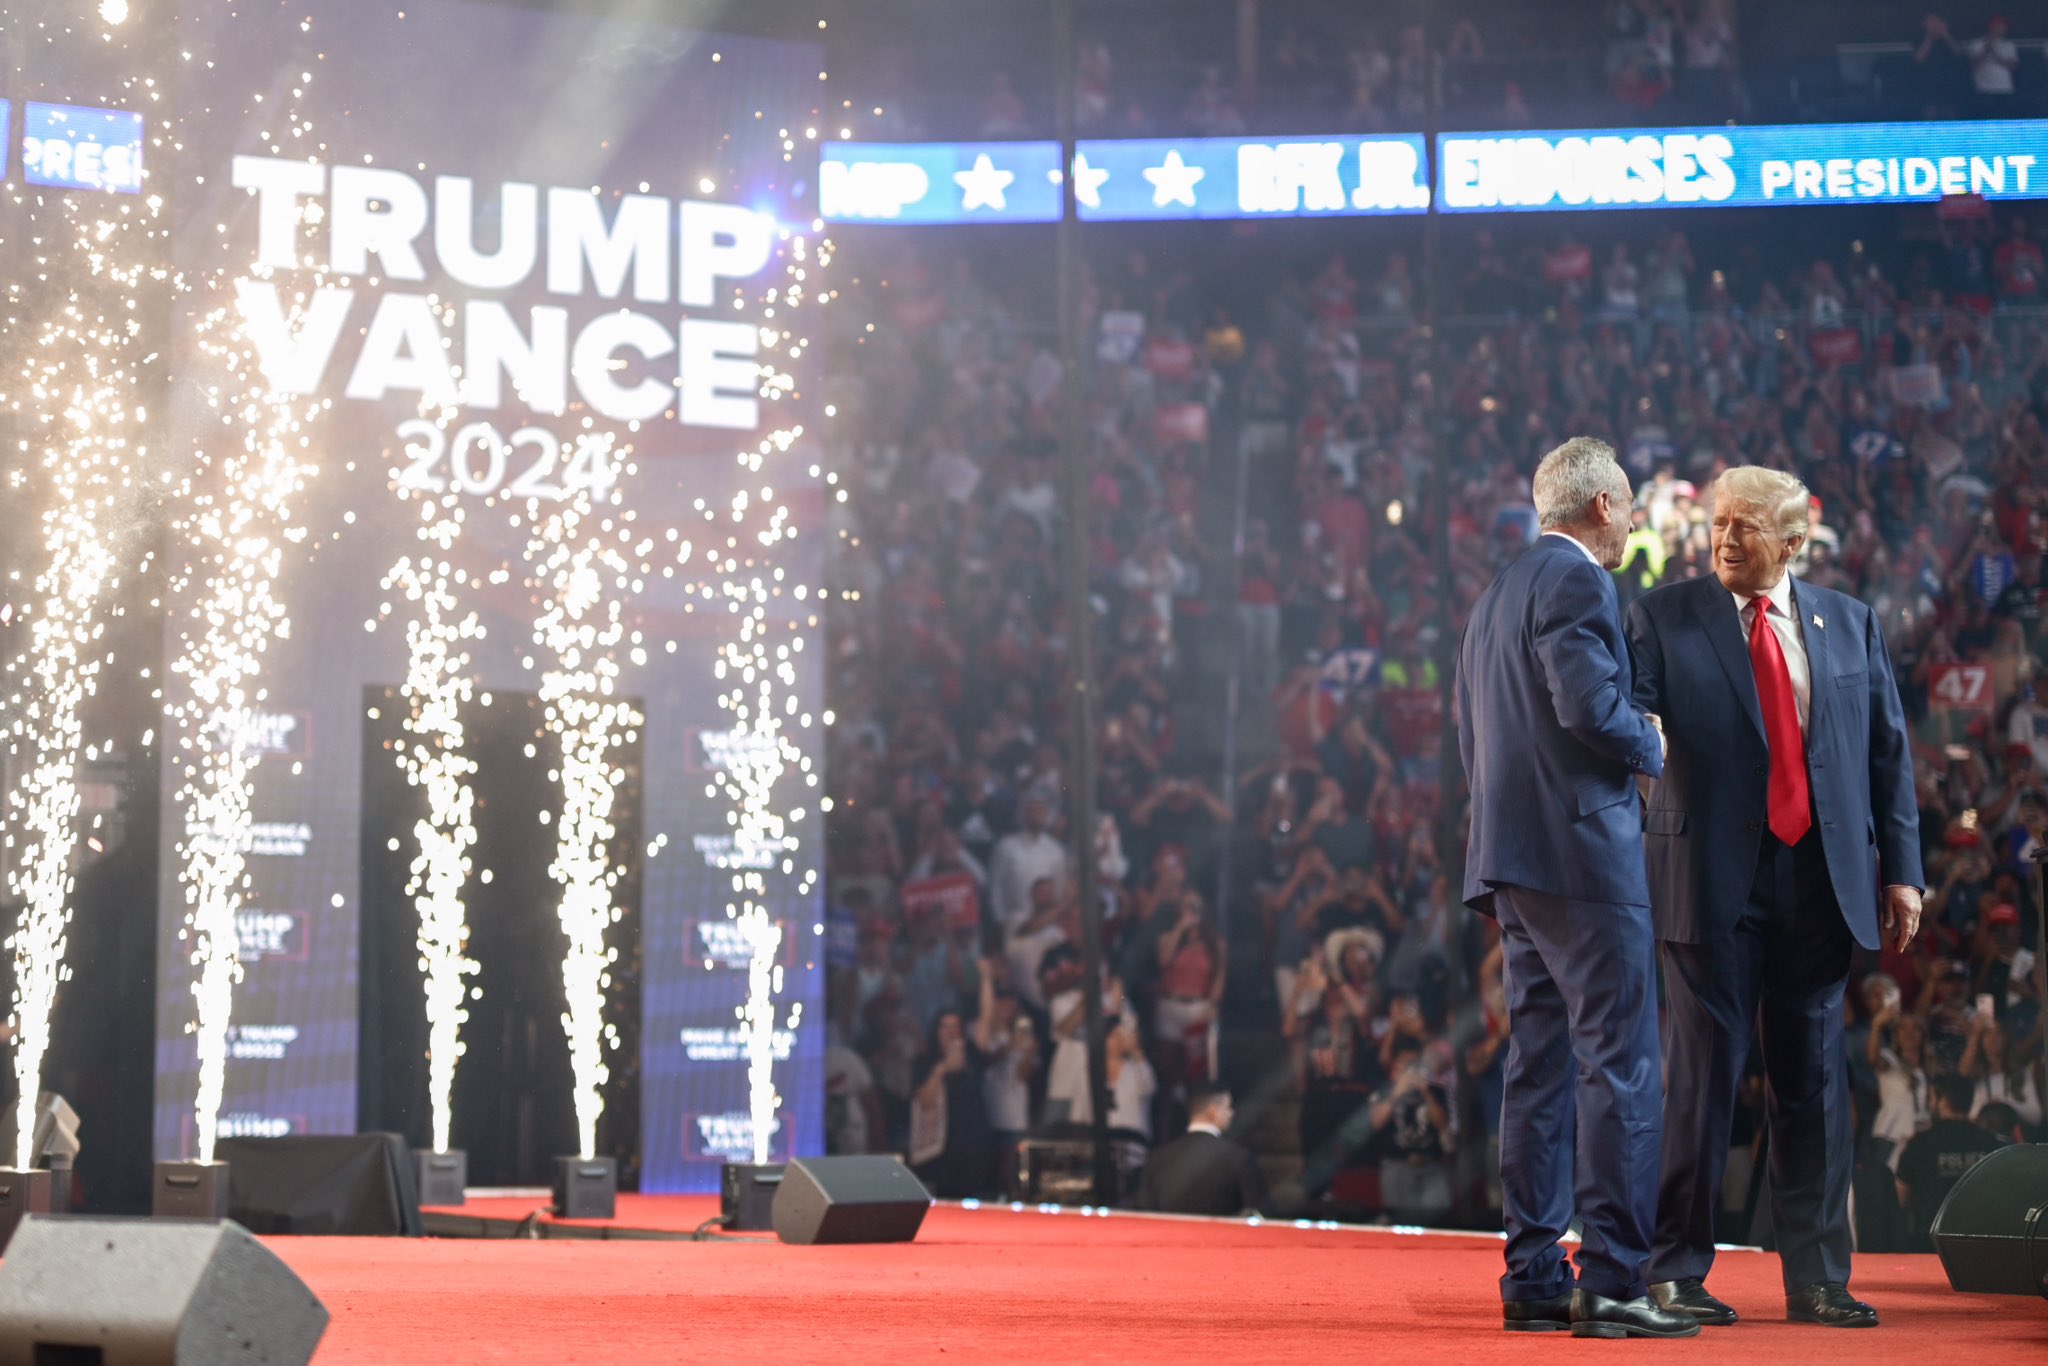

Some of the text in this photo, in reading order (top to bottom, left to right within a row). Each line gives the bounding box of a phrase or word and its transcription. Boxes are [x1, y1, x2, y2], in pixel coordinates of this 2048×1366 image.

[1761, 155, 2036, 199] PRESIDENT
[232, 155, 775, 308] TRUMP
[236, 279, 760, 430] VANCE
[396, 419, 617, 503] 2024
[1936, 667, 1987, 702] 47
